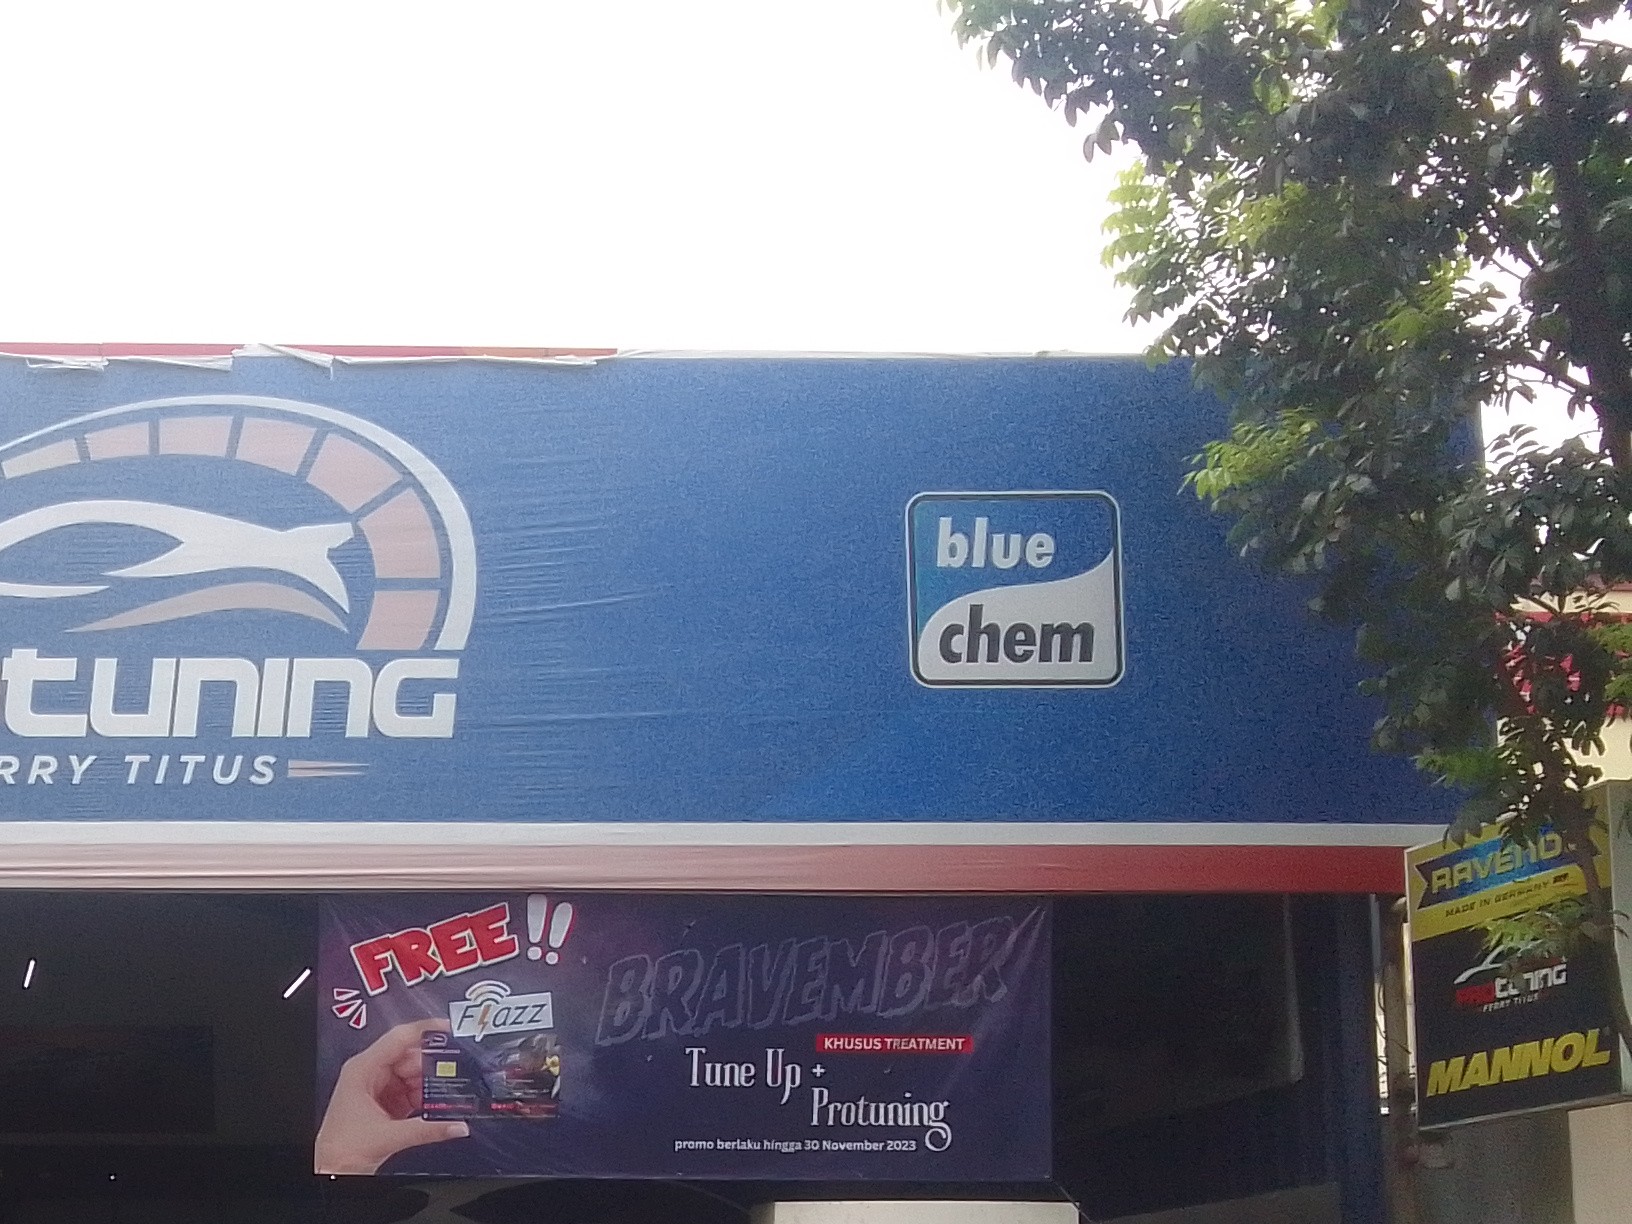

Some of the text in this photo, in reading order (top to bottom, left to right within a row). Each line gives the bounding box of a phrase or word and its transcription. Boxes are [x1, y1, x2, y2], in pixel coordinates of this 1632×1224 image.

[936, 516, 1055, 569] blue
[938, 603, 1095, 664] chem
[123, 754, 277, 785] TITUS
[1431, 831, 1563, 894] RAVENO
[1445, 902, 1476, 918] MADE
[1479, 897, 1490, 908] IN
[824, 1037, 966, 1051] KHUSUS TREATMENT
[1426, 1028, 1610, 1097] MANNOL
[685, 1047, 756, 1087] Tune
[765, 1048, 801, 1105] Up
[674, 1138, 916, 1153] promo berlaku hingga 30 November 2023
[811, 1087, 952, 1151] Protuning
